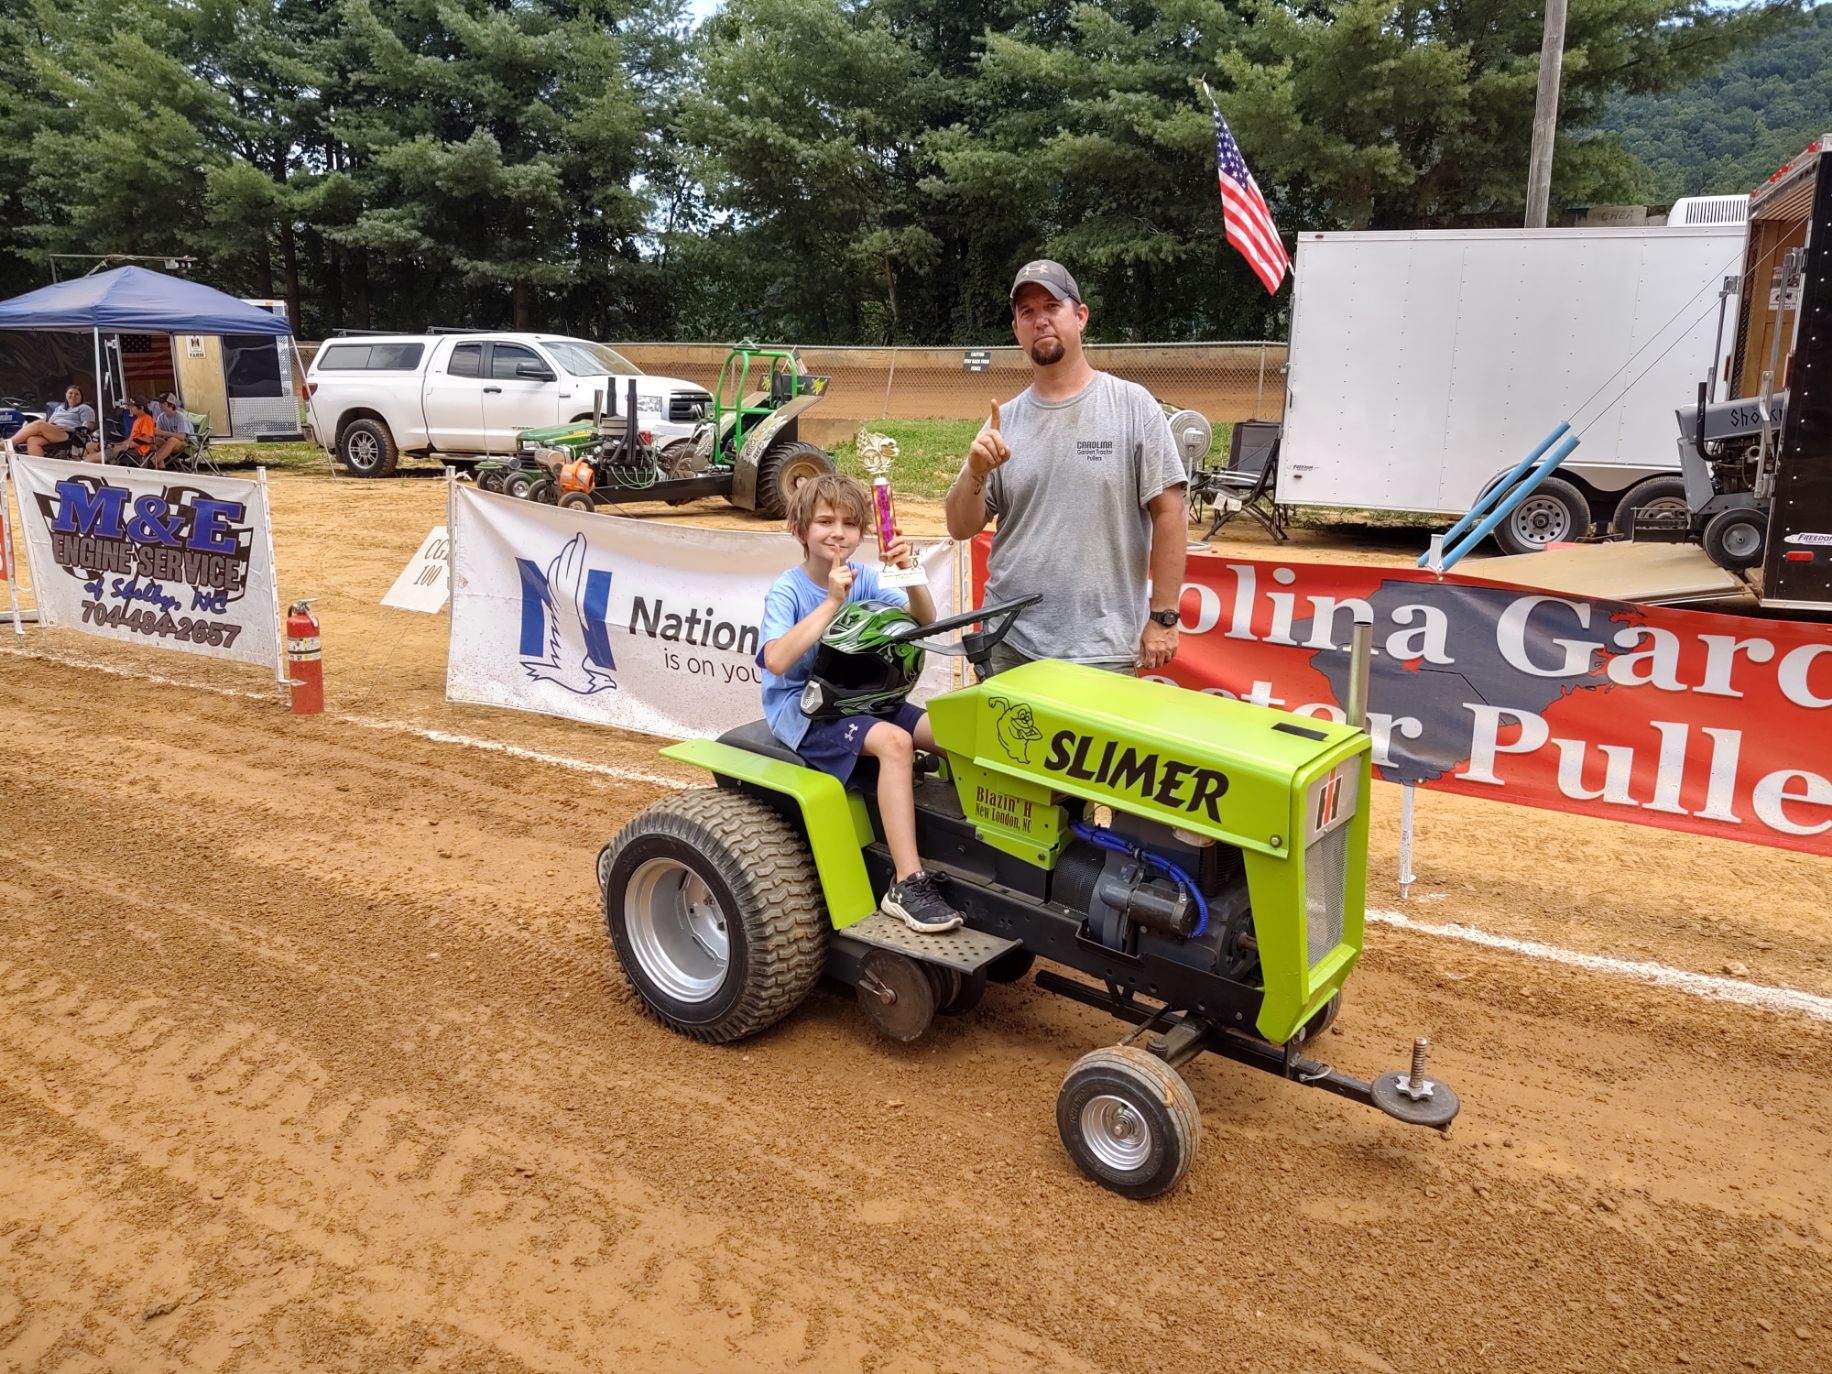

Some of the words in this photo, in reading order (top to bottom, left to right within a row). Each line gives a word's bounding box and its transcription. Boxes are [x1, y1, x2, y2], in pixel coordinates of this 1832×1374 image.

[1076, 441, 1113, 449] CAROLINA
[53, 532, 133, 575] ENGINE
[136, 545, 241, 591] SERVICE
[413, 565, 442, 587] 100
[191, 590, 228, 614] NC
[81, 599, 242, 648] 704-484-2657
[628, 596, 760, 655] Nation
[663, 647, 680, 671] is
[687, 657, 715, 677] on
[1043, 729, 1229, 824] SLIMER
[976, 785, 1020, 813] Blazin'
[976, 803, 989, 819] New
[1023, 817, 1032, 833] NC
